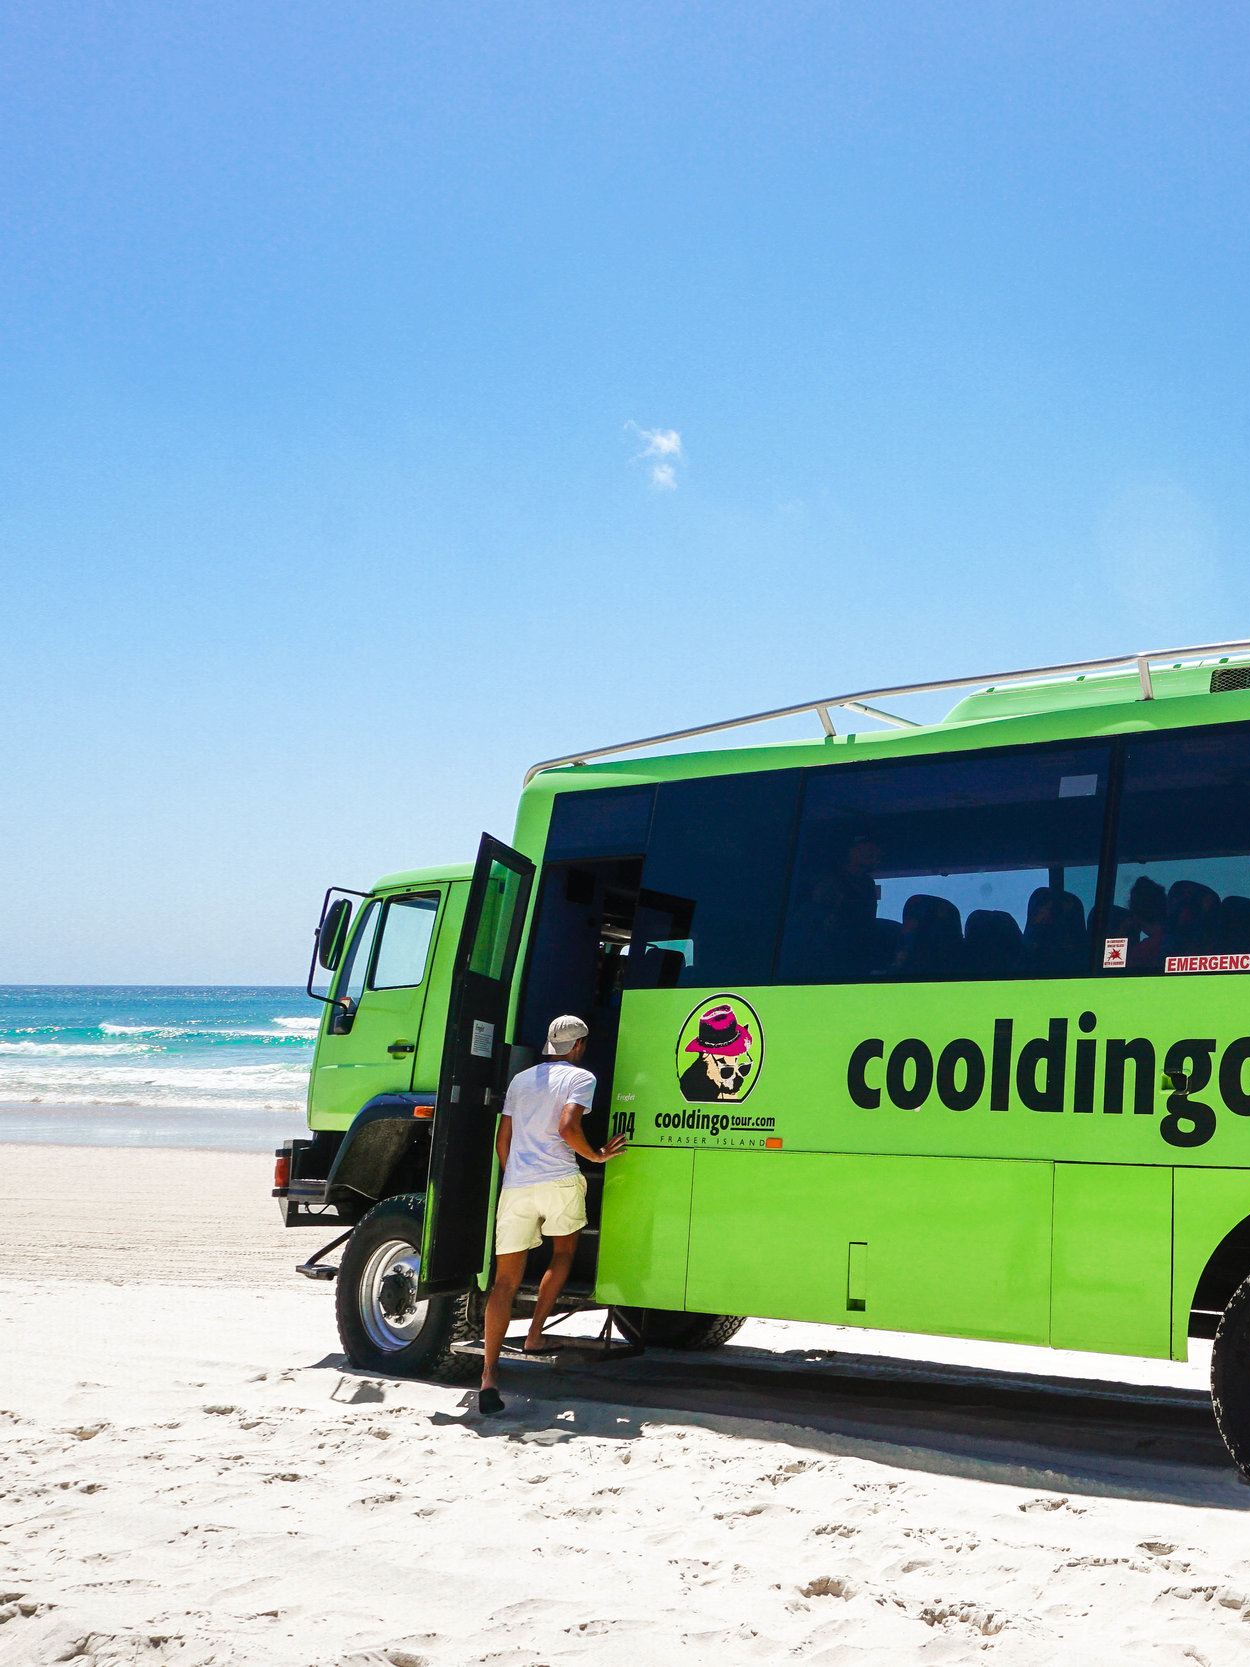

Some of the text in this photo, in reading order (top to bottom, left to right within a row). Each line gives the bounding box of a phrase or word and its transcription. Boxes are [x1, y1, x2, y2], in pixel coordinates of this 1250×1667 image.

[612, 1112, 636, 1141] 104
[655, 1109, 776, 1136] cooldingo tour.com
[660, 1136, 766, 1147] FRASER ISLAND
